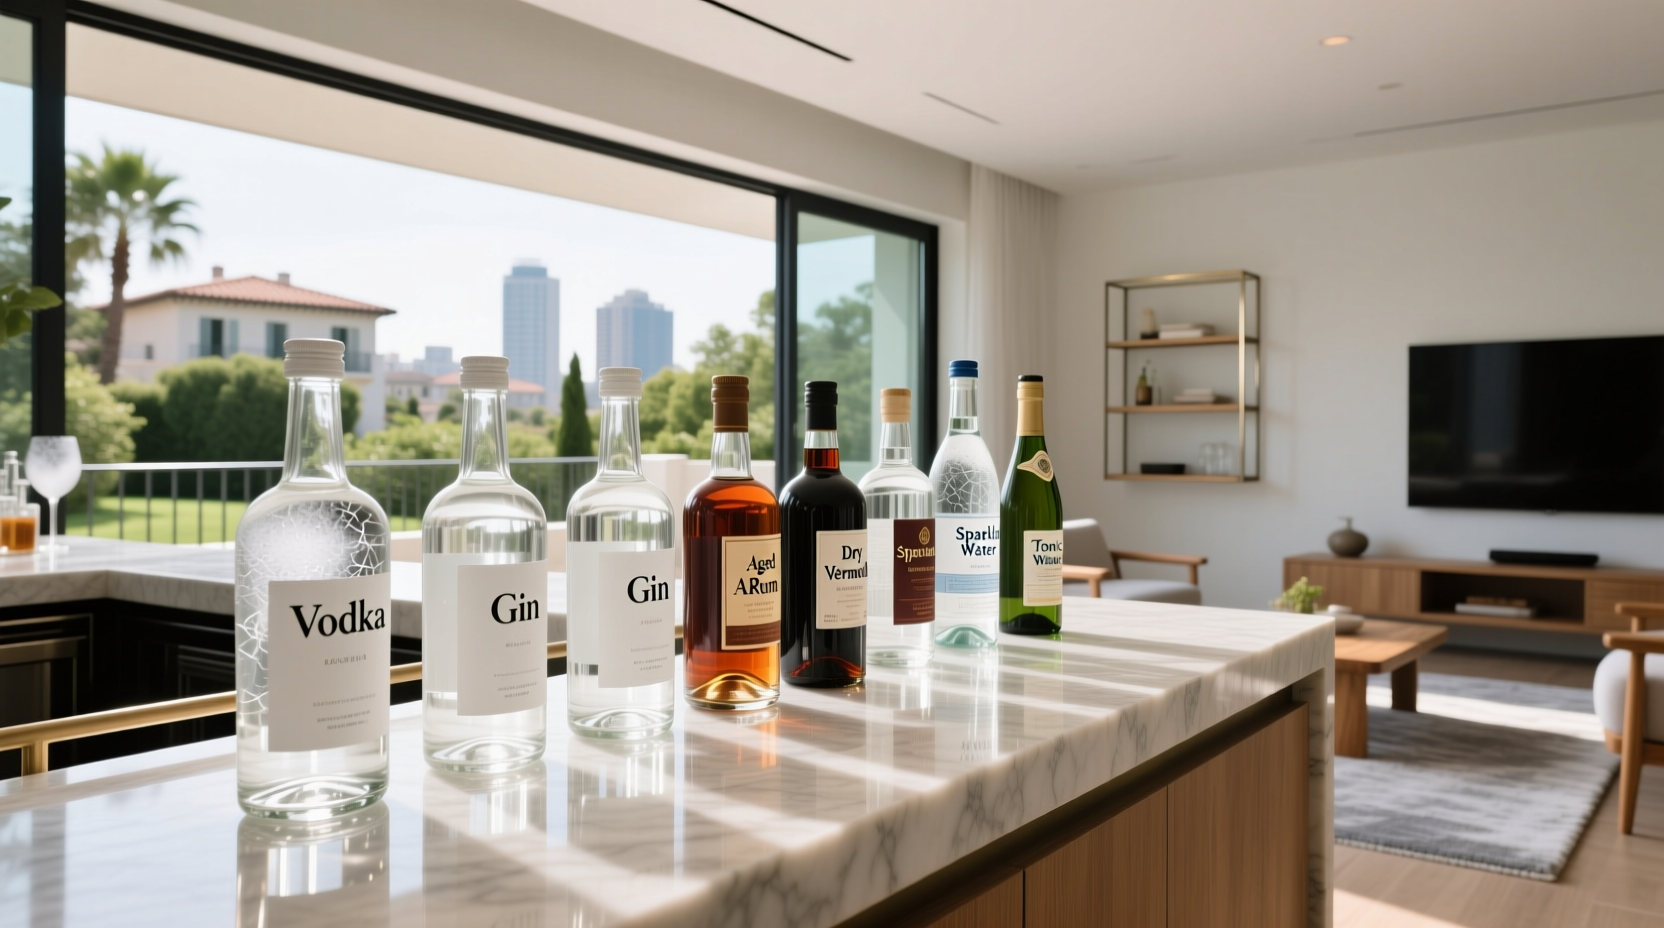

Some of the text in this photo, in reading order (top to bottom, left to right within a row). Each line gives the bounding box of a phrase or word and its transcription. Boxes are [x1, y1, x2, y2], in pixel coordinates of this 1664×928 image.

[746, 552, 776, 575] Aged
[841, 545, 862, 564] Dry
[627, 575, 669, 604] Gin
[289, 598, 385, 639] Vodka
[491, 592, 540, 625] Gin
